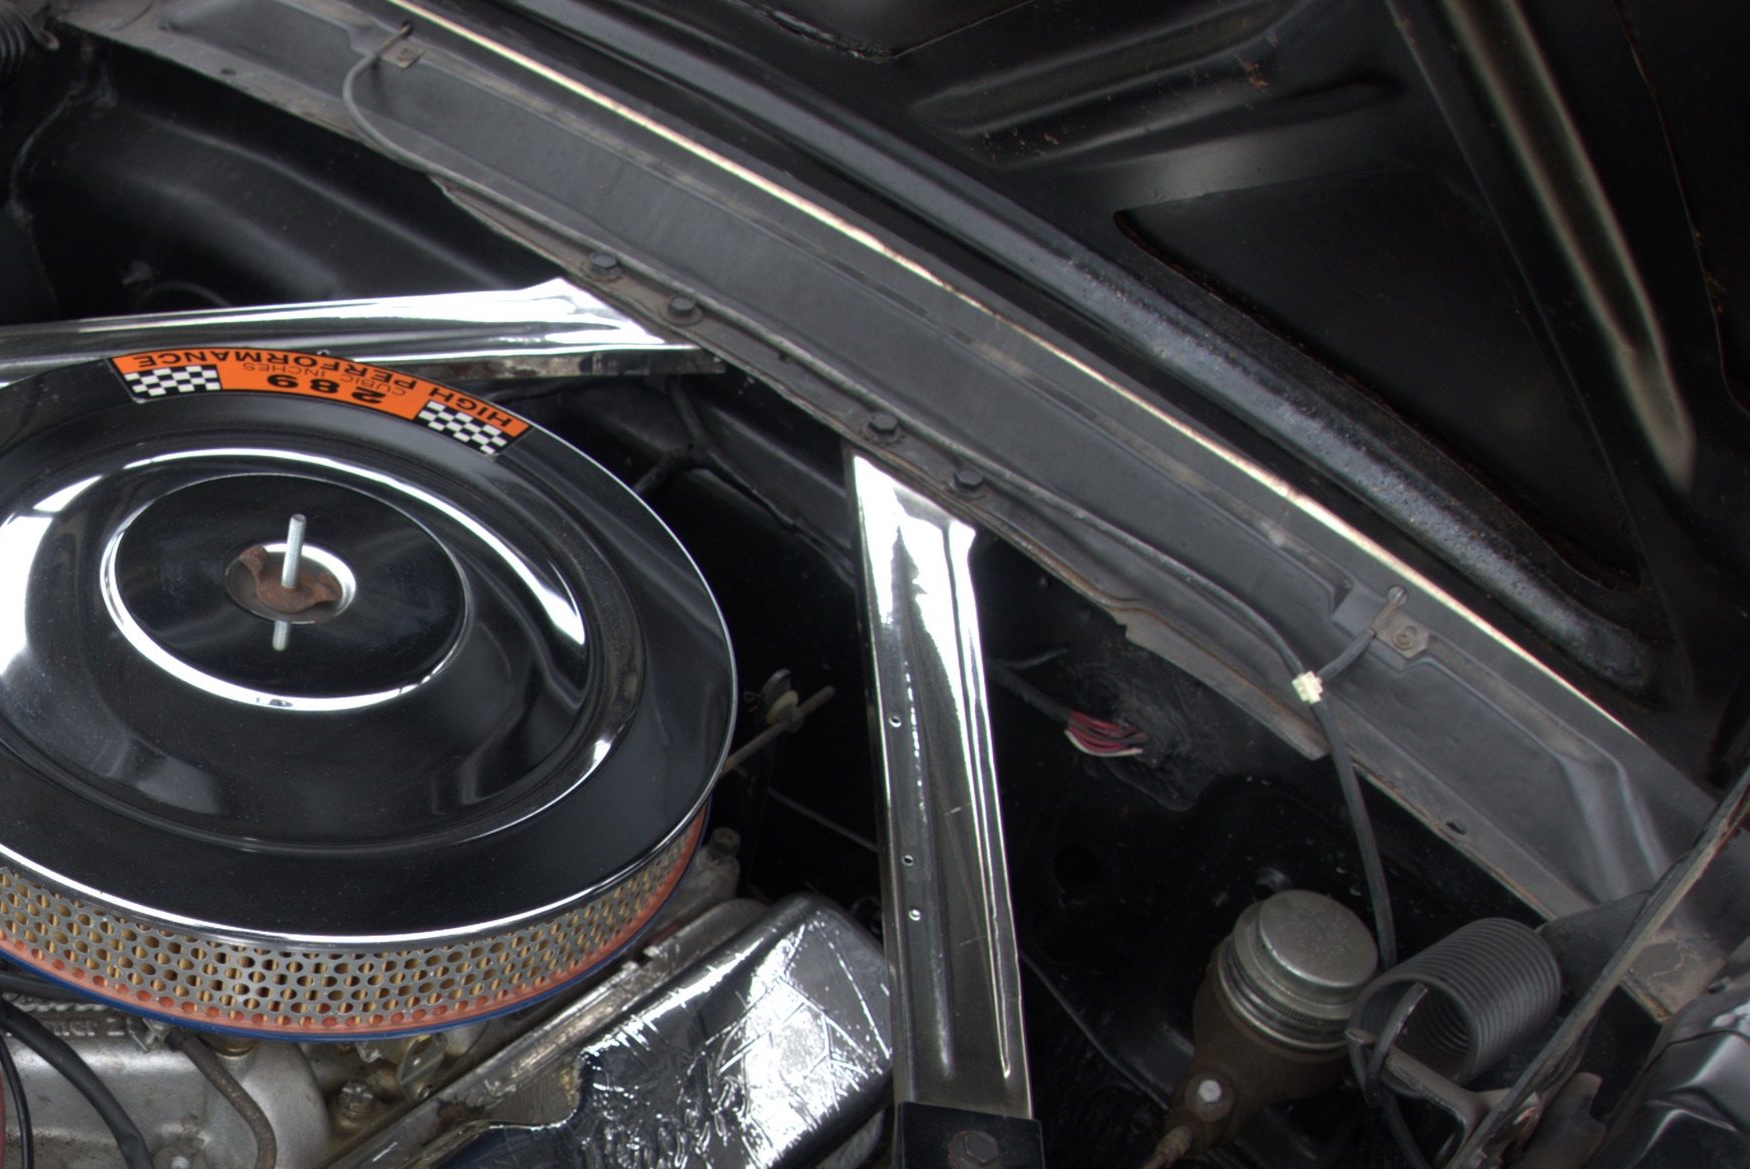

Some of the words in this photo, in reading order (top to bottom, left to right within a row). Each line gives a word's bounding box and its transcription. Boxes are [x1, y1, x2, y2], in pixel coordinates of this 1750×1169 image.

[133, 349, 418, 390] PERFORMANCE
[242, 362, 327, 378] INCHES
[267, 374, 387, 405] 289
[340, 375, 405, 396] CUBIC
[428, 386, 513, 429] HIGH
